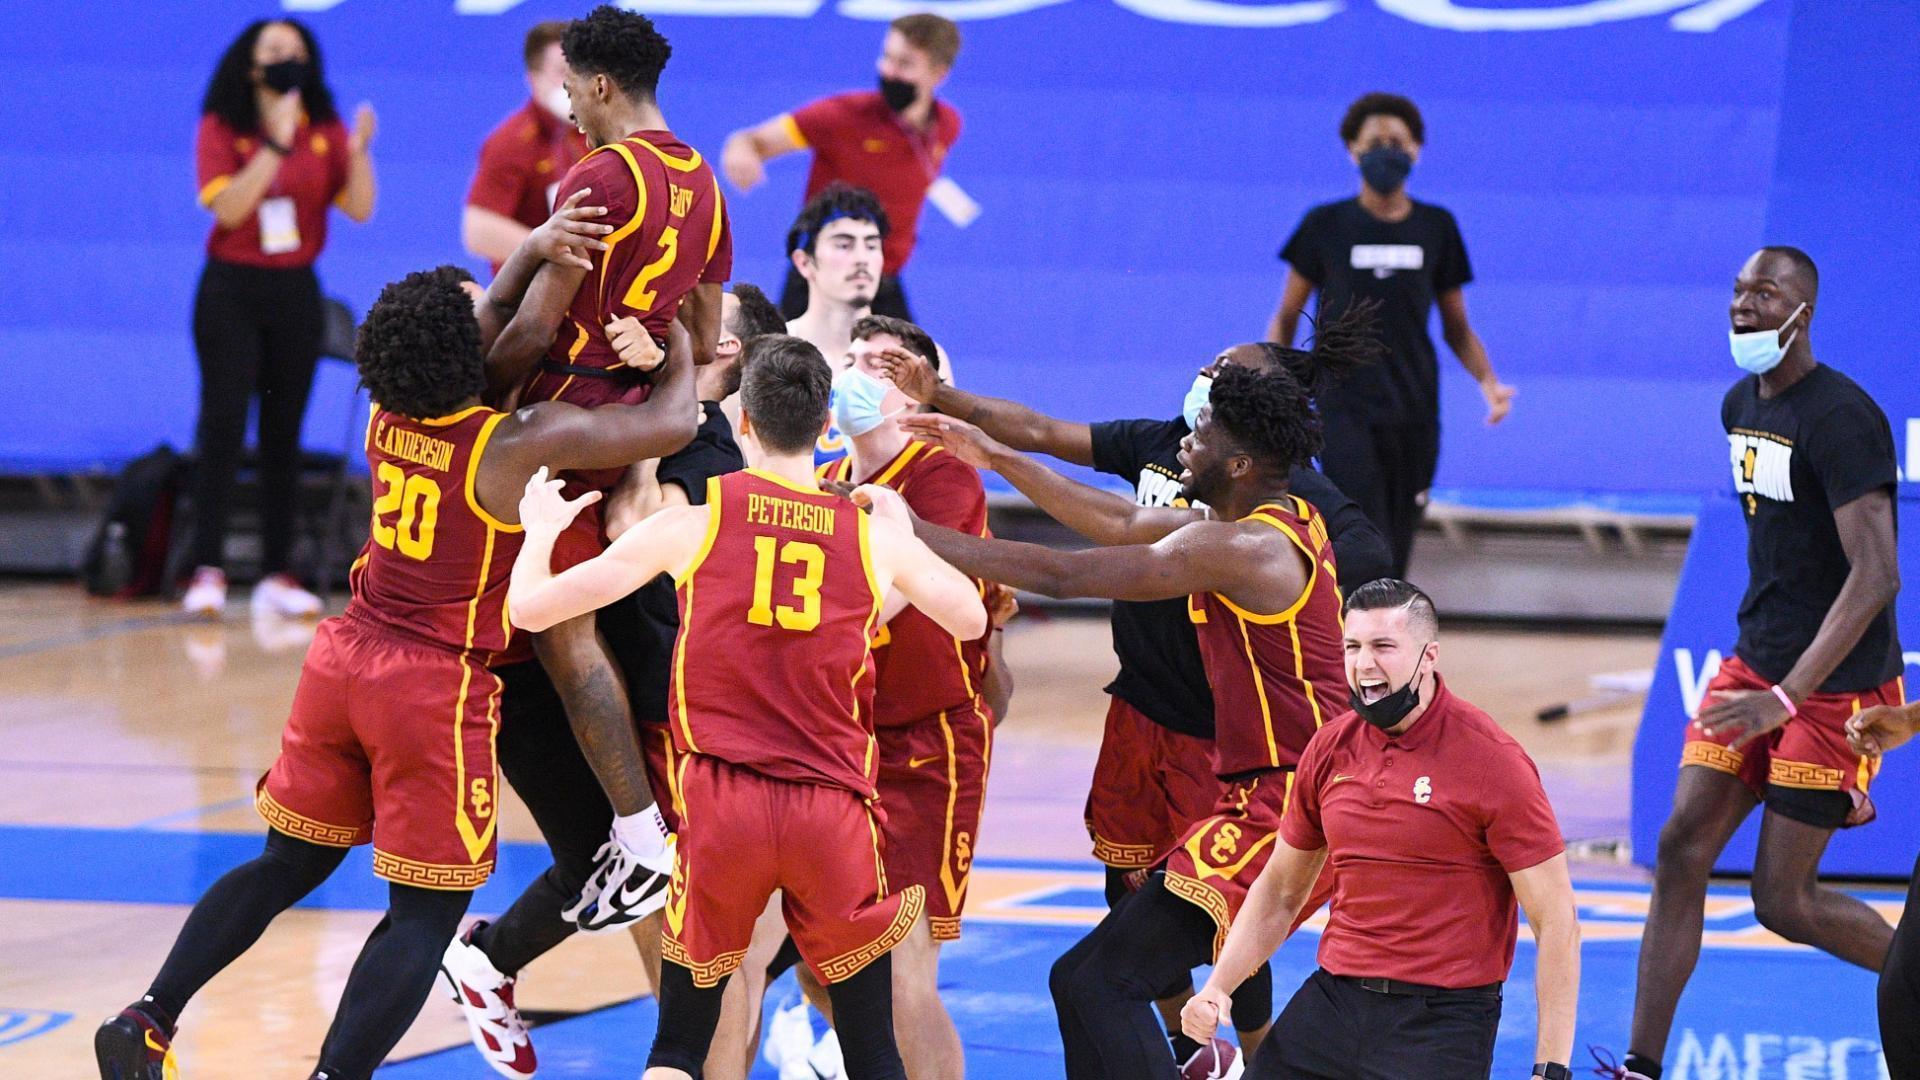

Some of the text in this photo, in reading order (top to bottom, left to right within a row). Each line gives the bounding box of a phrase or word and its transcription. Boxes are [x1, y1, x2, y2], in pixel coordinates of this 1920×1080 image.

[622, 225, 680, 312] 2
[372, 460, 442, 561] 20
[746, 493, 836, 536] PETERSON
[747, 535, 826, 632] 13
[471, 777, 491, 818] SC
[956, 831, 971, 872] SC
[1210, 822, 1242, 864] SC
